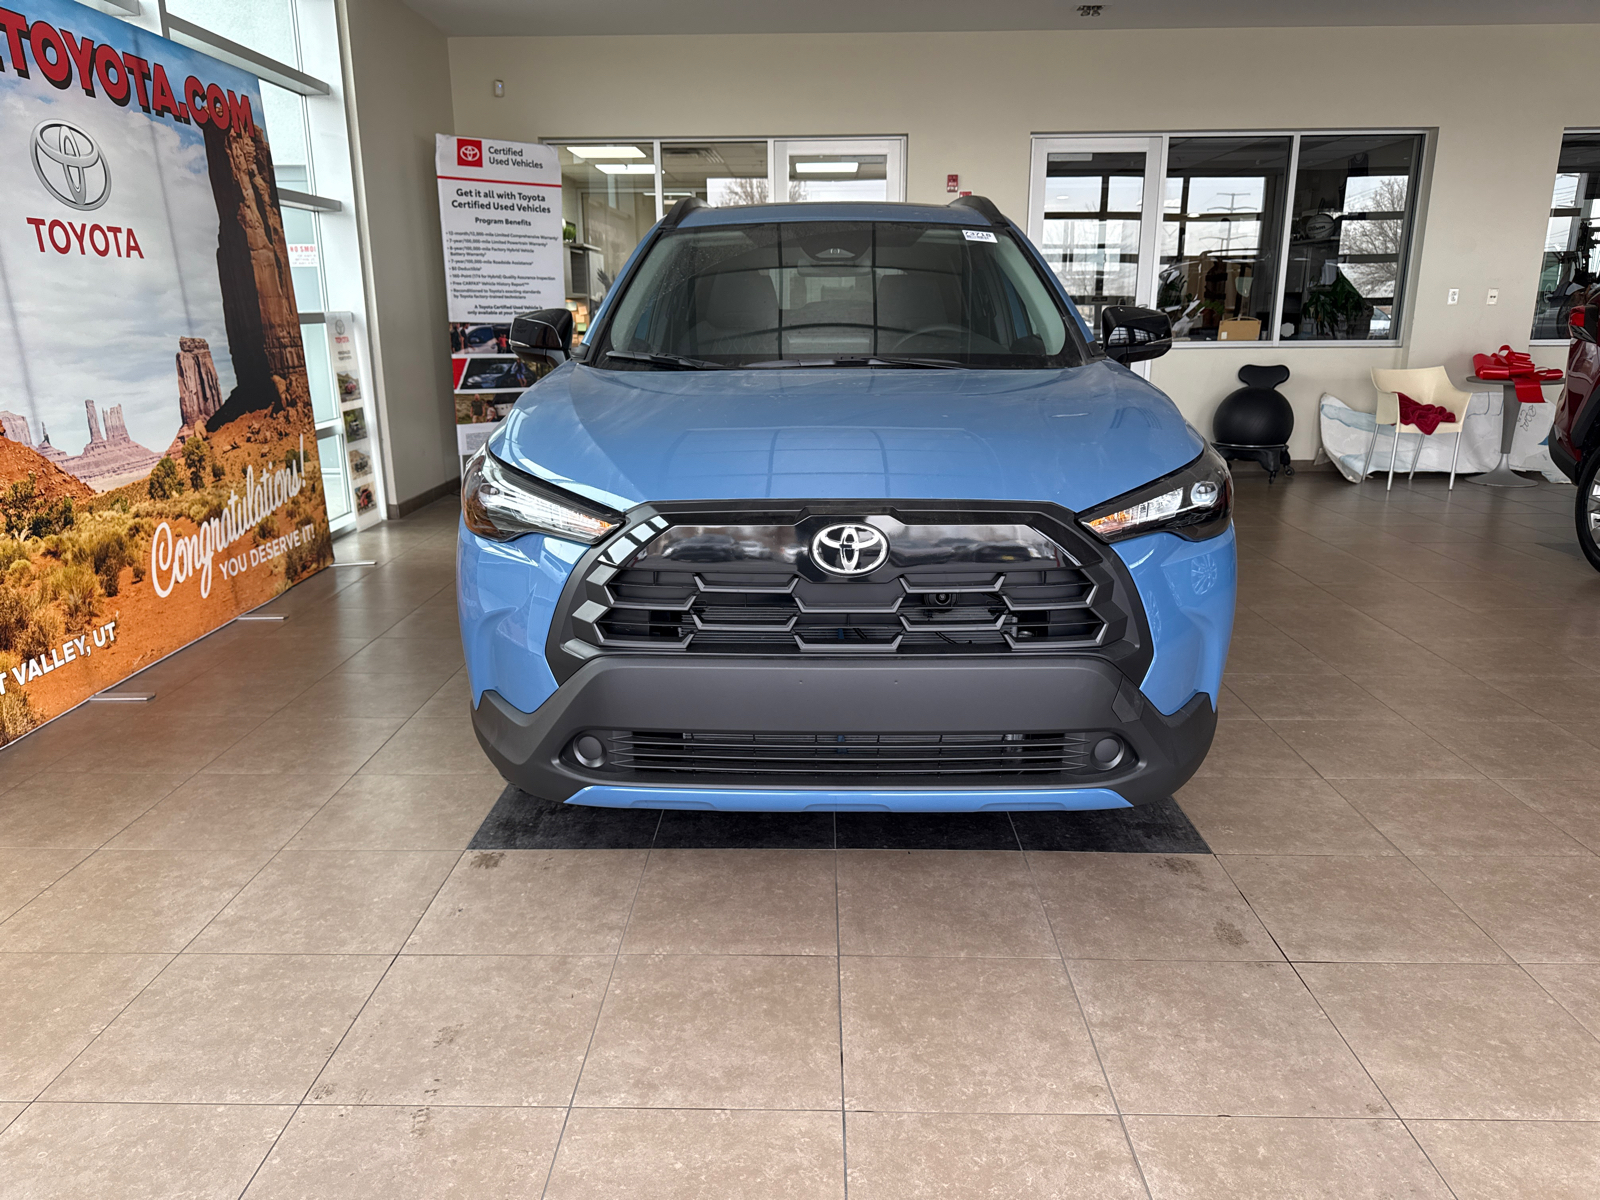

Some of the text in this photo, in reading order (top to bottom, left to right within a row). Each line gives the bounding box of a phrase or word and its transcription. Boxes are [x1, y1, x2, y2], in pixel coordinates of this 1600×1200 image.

[0, 7, 256, 137] TOYOTA.COM
[488, 146, 523, 157] Certified
[489, 156, 543, 169] Used Vehicles
[451, 199, 551, 214] Certified Used Vehicles
[456, 188, 546, 203] Get it all with Toyota
[475, 217, 531, 226] Program Benefits
[26, 216, 145, 259] TOYOTA
[151, 433, 306, 599] Congratulations!
[218, 522, 315, 581] YOU DESERVE IT!
[11, 634, 91, 687] VALLEY,
[92, 621, 116, 648] UT
